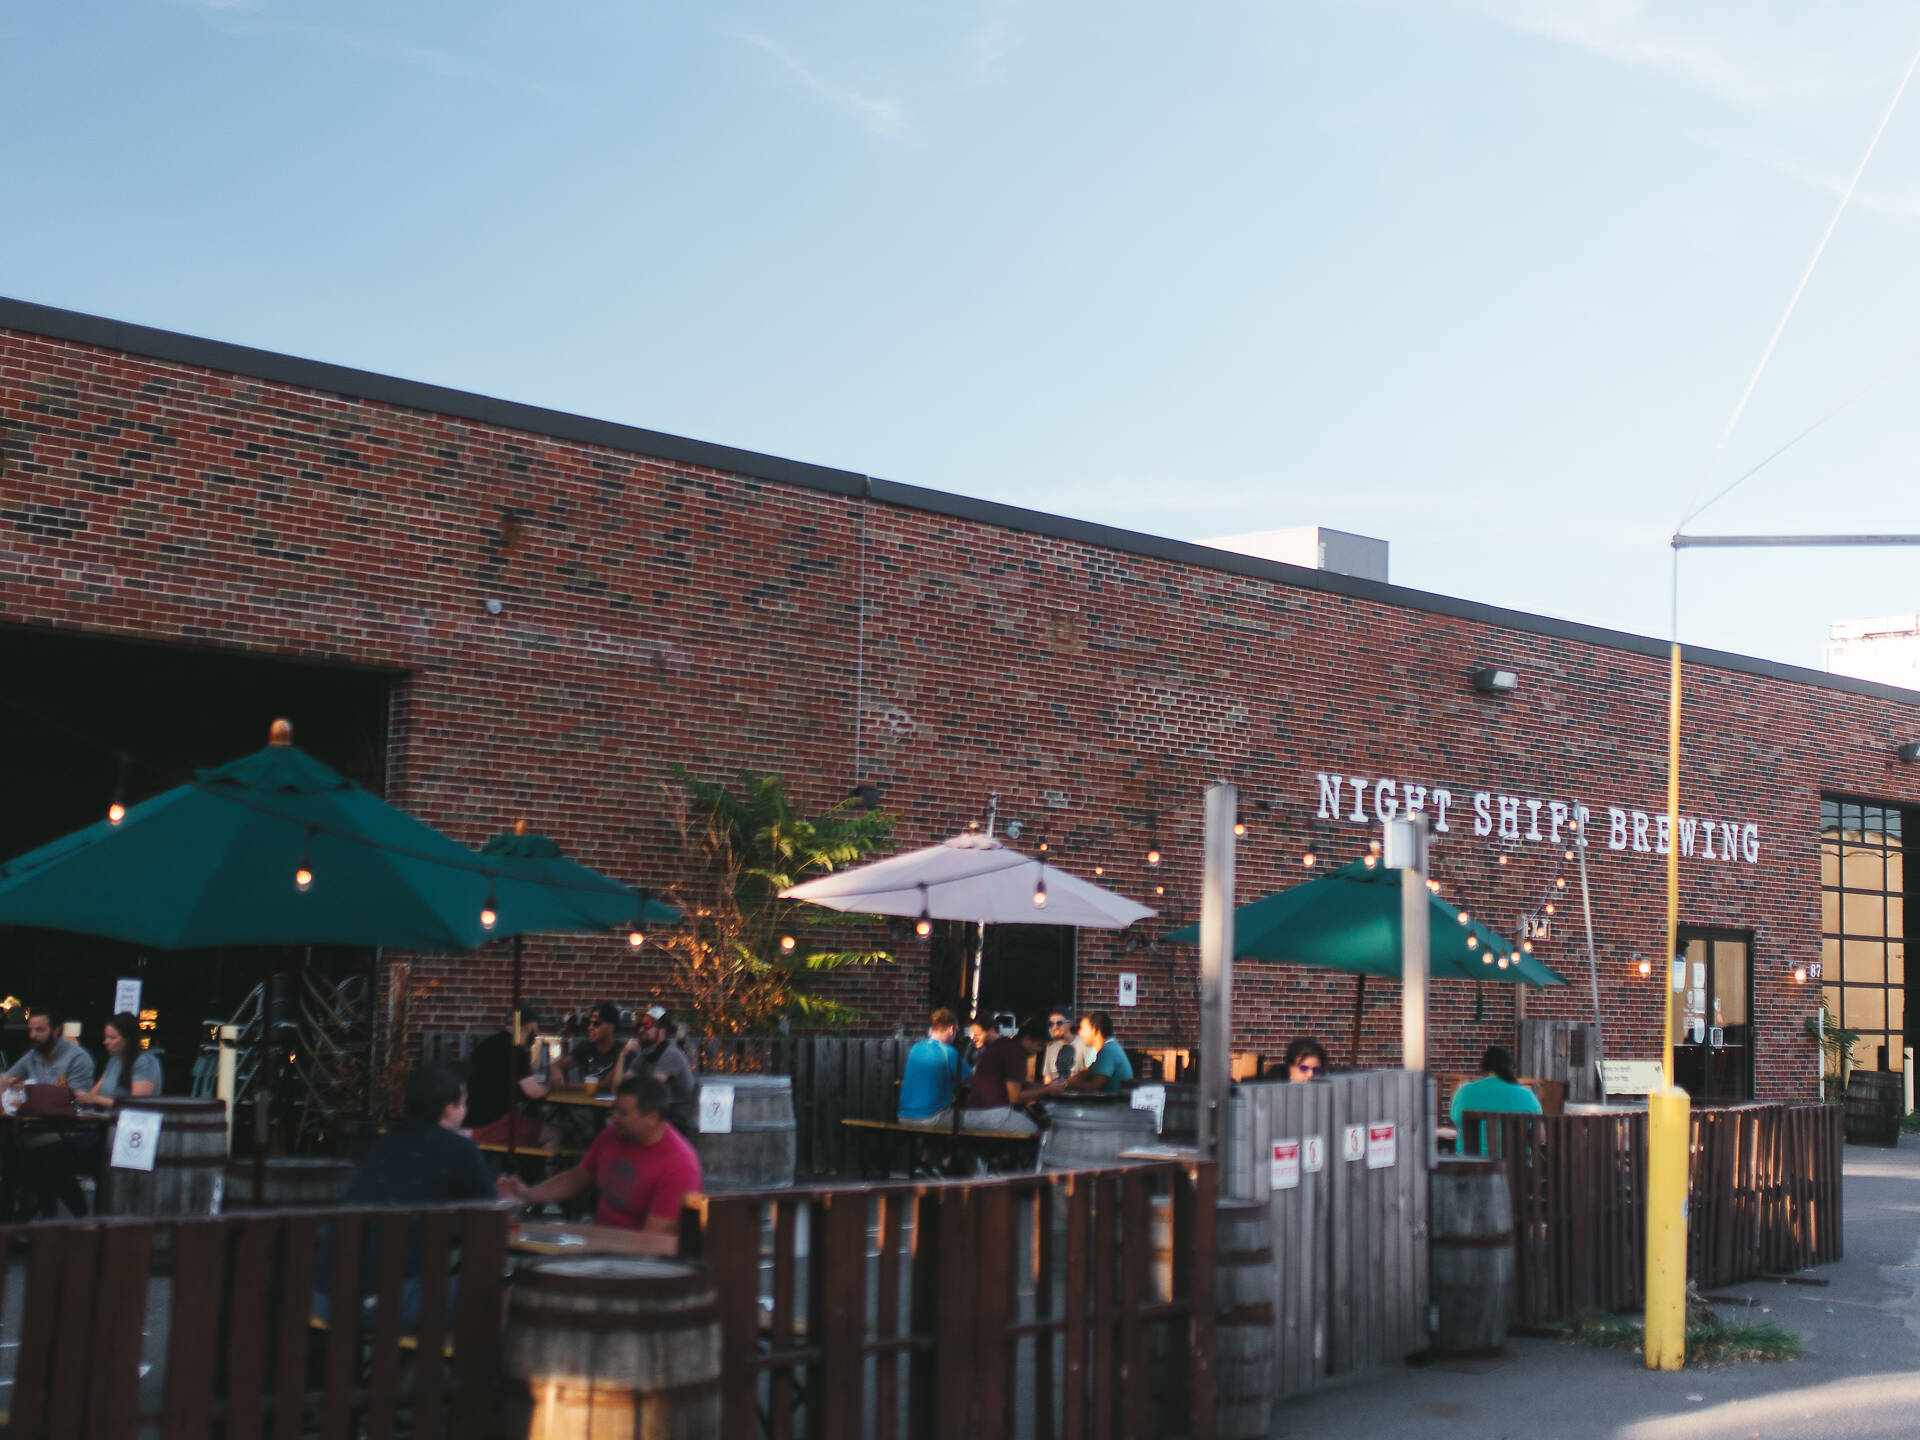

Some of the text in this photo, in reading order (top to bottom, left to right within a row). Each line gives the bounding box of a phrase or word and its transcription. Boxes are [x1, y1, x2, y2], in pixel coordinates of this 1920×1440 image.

[1316, 773, 1760, 864] NIGHT SHIFT BREWING
[1525, 918, 1550, 939] EXT
[712, 1102, 721, 1115] 7
[130, 1132, 142, 1149] 8
